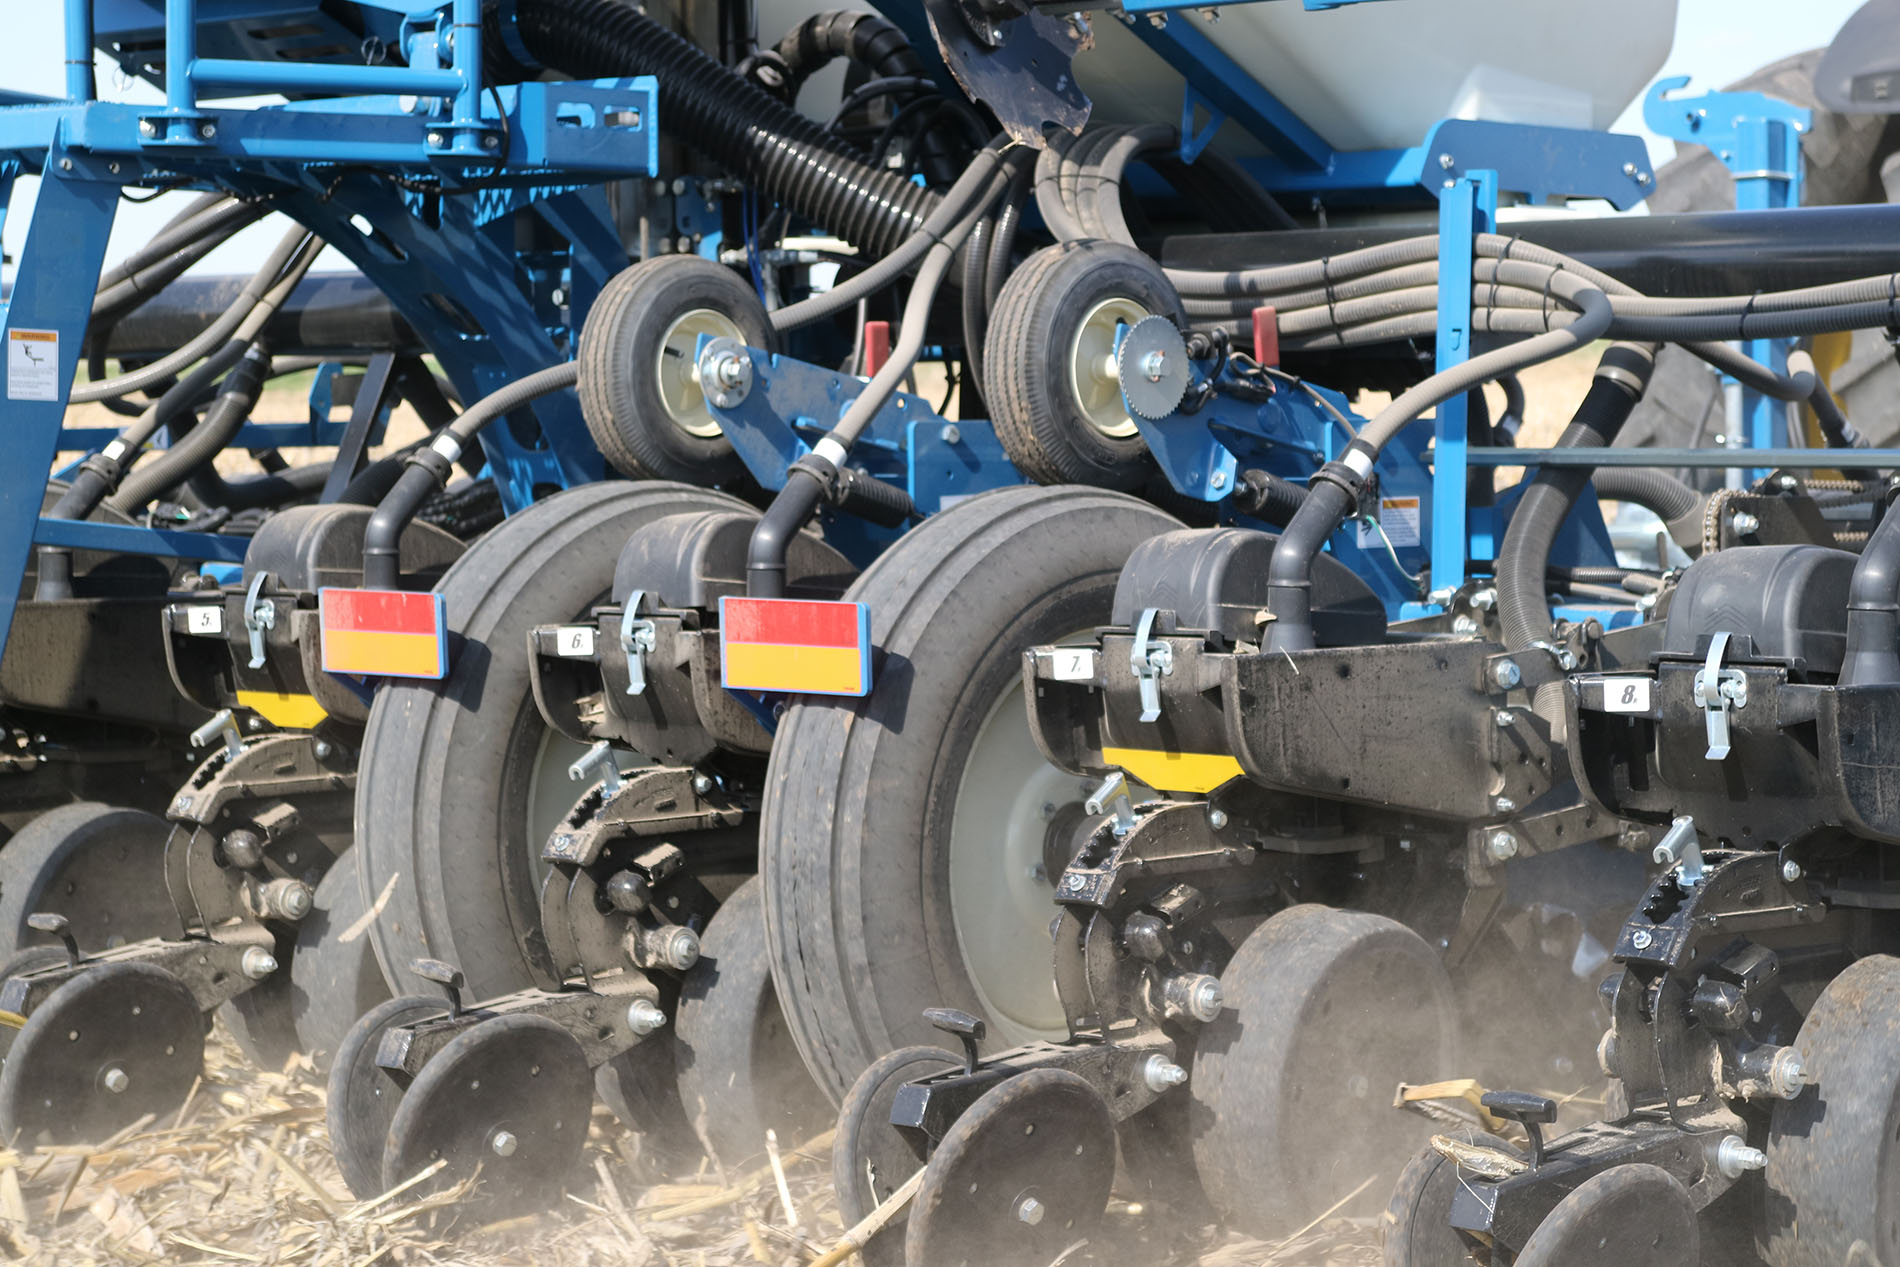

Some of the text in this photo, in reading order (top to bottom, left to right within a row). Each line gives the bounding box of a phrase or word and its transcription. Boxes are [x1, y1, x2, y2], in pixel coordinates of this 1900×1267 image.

[571, 633, 582, 649] 6
[1070, 655, 1080, 672] 7
[1621, 684, 1636, 704] 8
